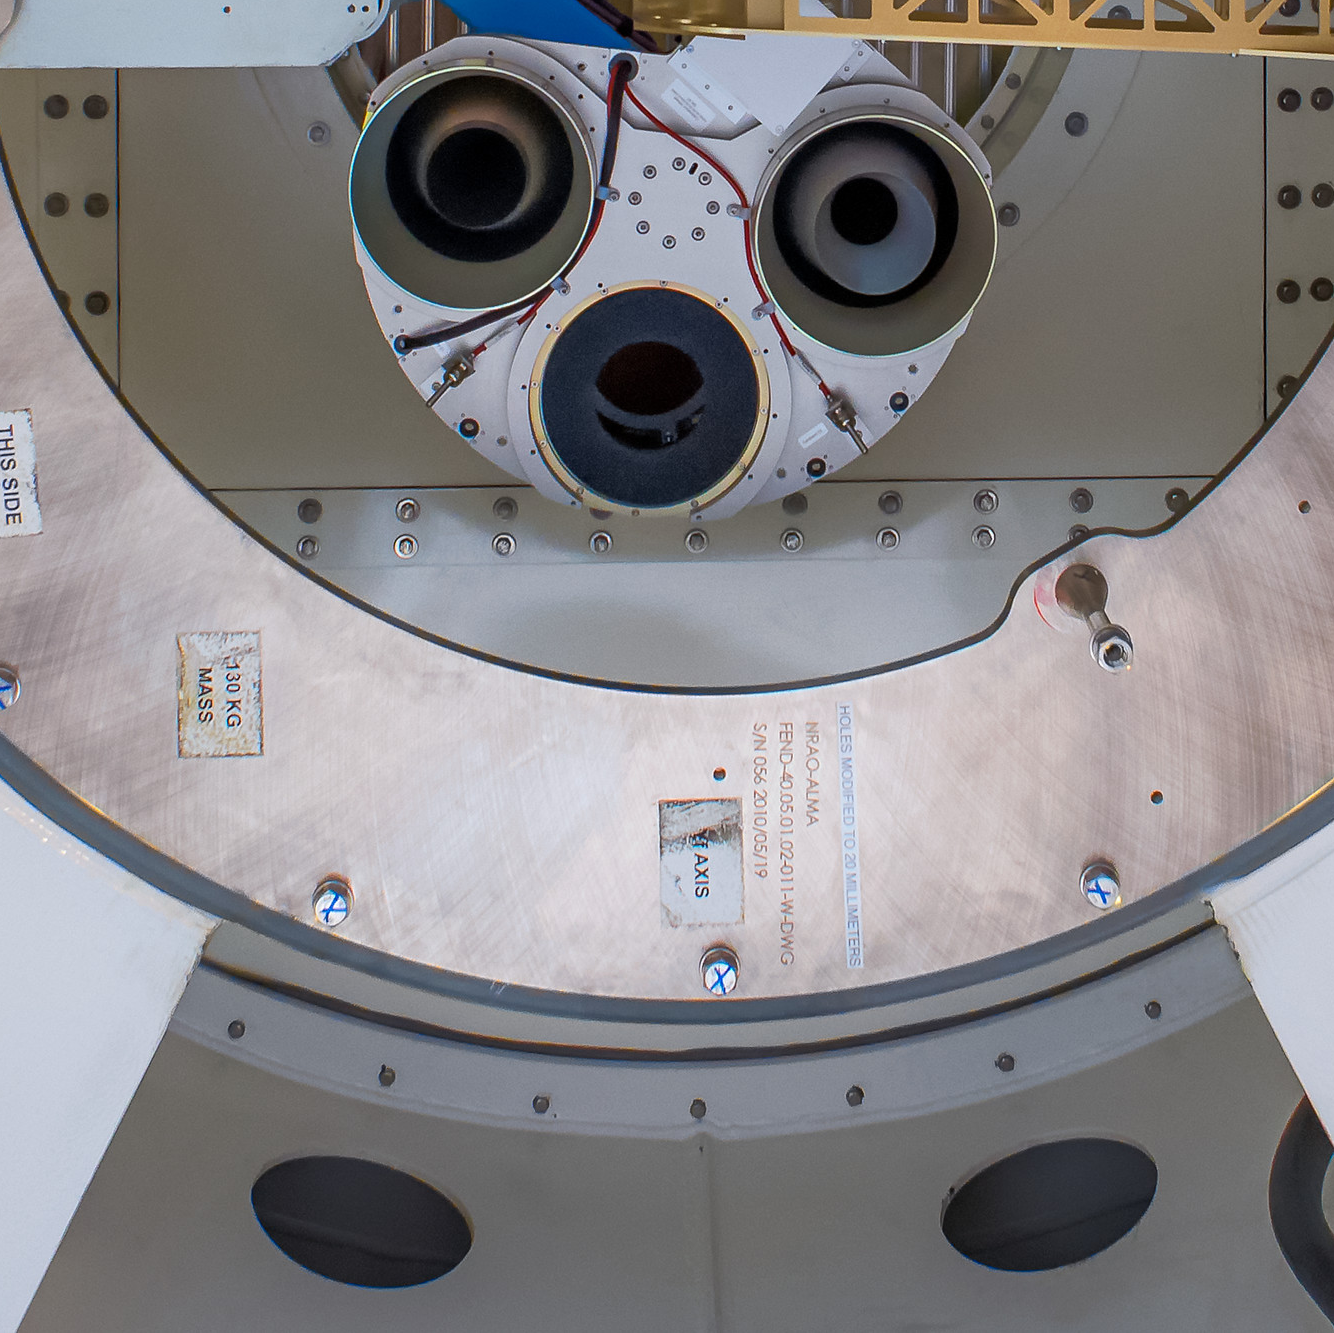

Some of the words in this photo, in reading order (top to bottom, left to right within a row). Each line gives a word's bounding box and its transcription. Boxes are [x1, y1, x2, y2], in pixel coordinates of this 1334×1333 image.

[2, 478, 22, 525] SIDE
[198, 668, 214, 724] MASS
[226, 662, 240, 692] 130
[227, 700, 242, 728] KG
[839, 706, 852, 753] HOLES
[754, 723, 767, 751] S/N
[754, 756, 767, 784] 056
[805, 722, 820, 825] NRAO-ALMA
[841, 758, 854, 825] MODIFIED
[753, 790, 768, 878] 2010/05/19
[844, 830, 856, 848] TO
[694, 854, 710, 898] AXIS
[845, 853, 856, 869] 20
[845, 873, 861, 967] MILLIMETERS
